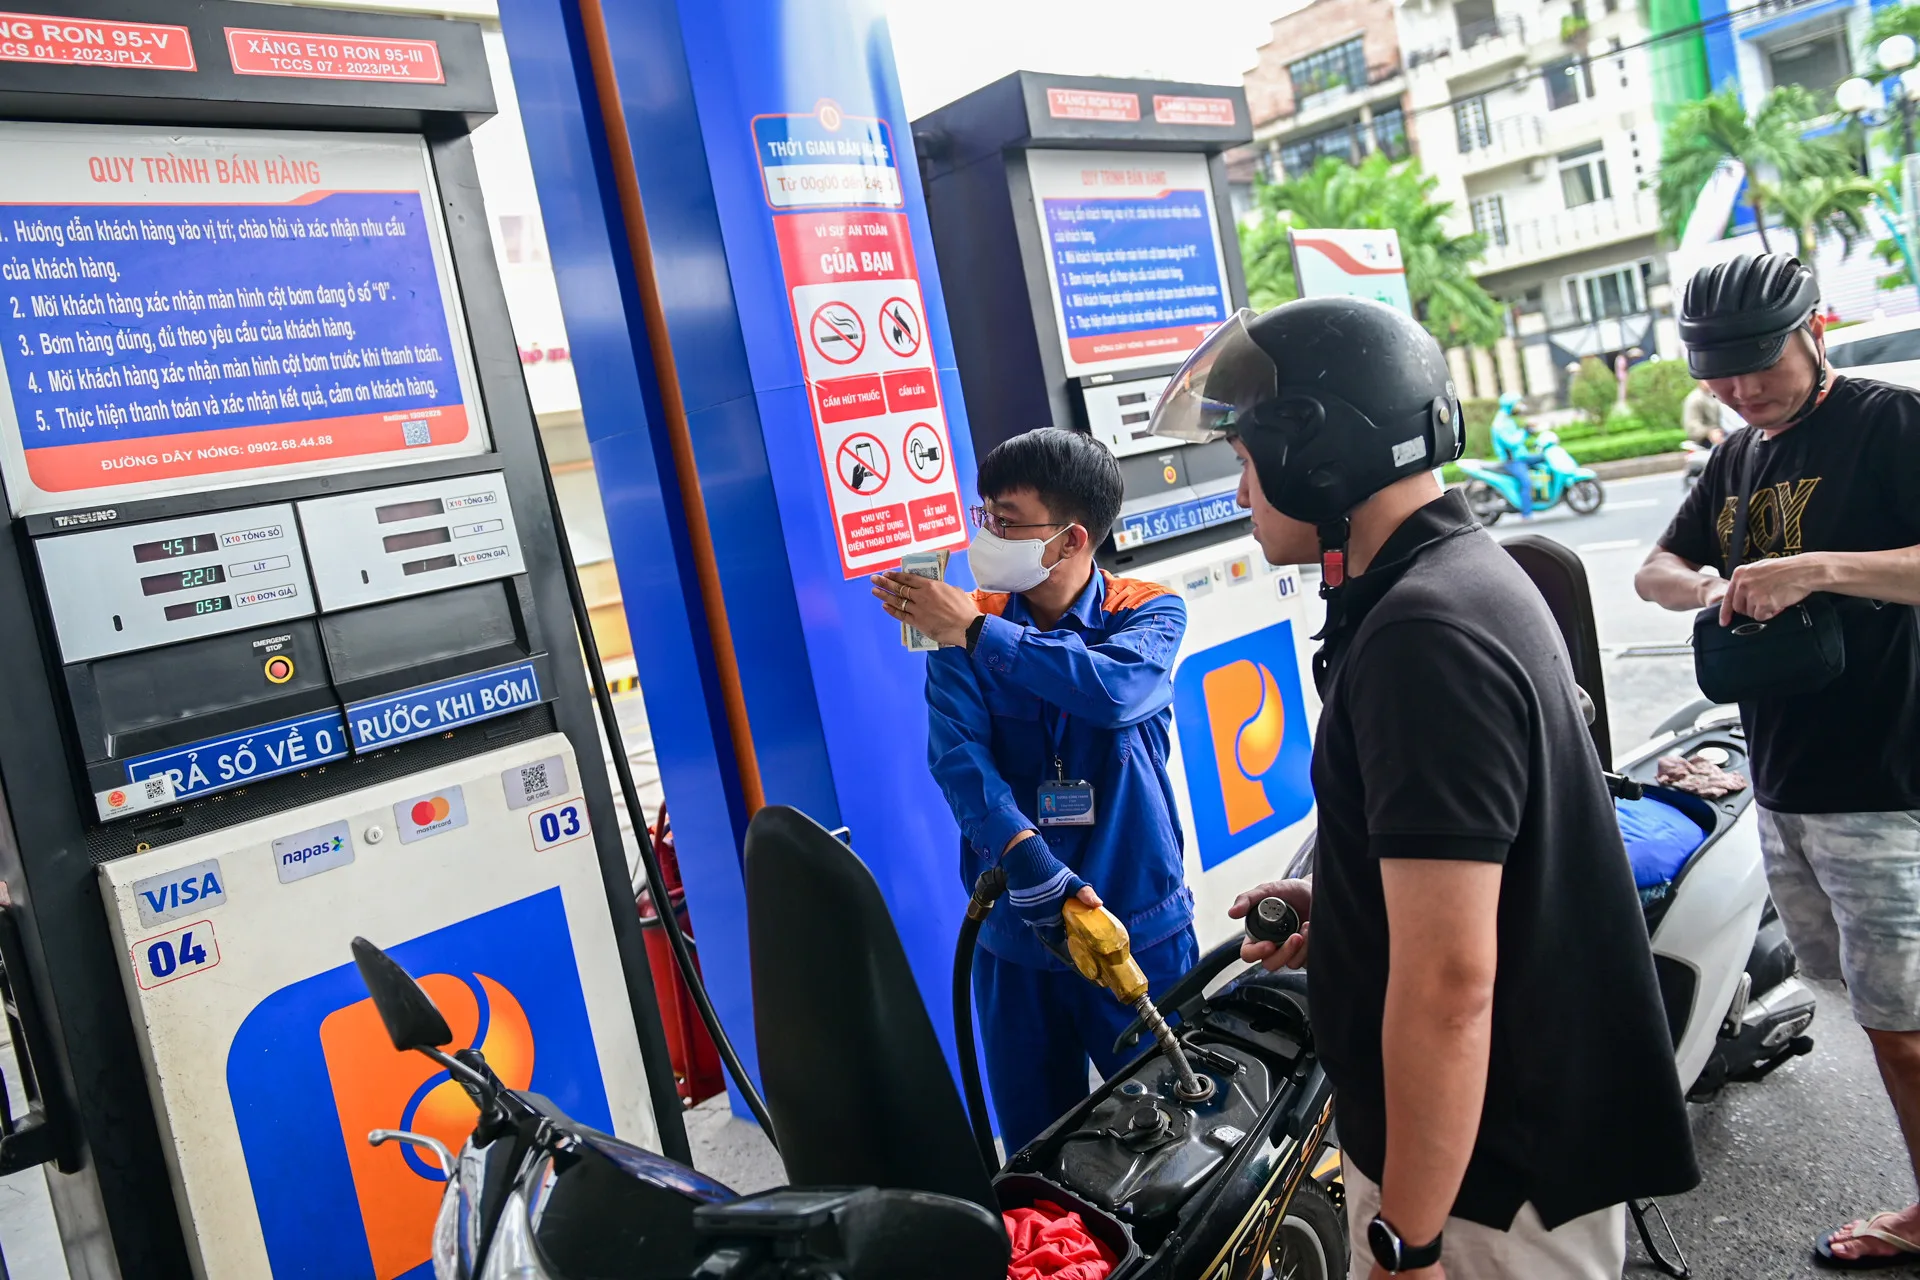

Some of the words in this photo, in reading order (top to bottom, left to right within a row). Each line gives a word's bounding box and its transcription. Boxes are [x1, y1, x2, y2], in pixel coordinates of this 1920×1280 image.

[42, 24, 104, 45] RON
[112, 31, 169, 49] 95-V
[34, 44, 54, 58] 01
[72, 47, 154, 64] 2023/PLX
[247, 37, 301, 56] XĂNG
[308, 44, 338, 58] E10
[343, 46, 380, 61] RON
[386, 48, 423, 63] 95-III
[271, 58, 313, 71] TCCS
[318, 60, 333, 72] 07
[347, 62, 410, 76] 2023/PLX
[768, 137, 804, 157] THỜI
[806, 141, 835, 156] GIAN
[88, 156, 134, 182] QUY
[141, 152, 210, 184] TRÌNH
[215, 154, 260, 184] BÁN
[264, 154, 321, 184] HÀNG
[777, 177, 797, 192] Từ
[13, 219, 65, 247] Hướng
[66, 215, 94, 242] dẫn
[95, 219, 139, 241] khách
[139, 219, 176, 246] hàng
[176, 219, 201, 240] vào
[202, 219, 217, 245] vị
[216, 218, 237, 243] trí;
[238, 218, 269, 239] chào
[268, 217, 289, 239] hỏi
[289, 217, 307, 238] và
[306, 217, 329, 238] xác
[329, 217, 361, 242] nhận
[360, 217, 385, 238] nhu
[384, 214, 407, 238] cầu
[848, 225, 862, 237] AN
[863, 222, 888, 237] TOÀN
[2, 256, 31, 281] của
[31, 257, 78, 279] khách
[79, 256, 121, 283] hàng.
[820, 246, 858, 275] CỦA
[861, 251, 895, 277] BẠN
[9, 296, 25, 319] 2.
[31, 295, 59, 317] Mời
[60, 293, 106, 316] khách
[106, 292, 144, 319] hàng
[144, 290, 170, 313] xác
[171, 289, 206, 315] nhận
[207, 288, 236, 309] màn
[235, 287, 266, 308] hình
[267, 285, 288, 311] cột
[287, 285, 315, 306] bơm
[316, 284, 347, 308] đang
[357, 280, 372, 303] số
[18, 334, 34, 357] 3.
[39, 333, 75, 355] Bơm
[75, 330, 115, 357] hàng
[115, 328, 157, 354] đúng,
[157, 324, 177, 348] đủ
[177, 325, 207, 347] theo
[208, 323, 234, 350] yêu
[235, 319, 259, 343] cầu
[260, 319, 284, 341] của
[283, 318, 322, 340] khách
[321, 317, 356, 341] hàng.
[35, 409, 51, 431] 5.
[55, 407, 95, 433] Thực
[95, 403, 128, 429] hiện
[129, 399, 170, 423] thanh
[170, 396, 202, 419] toán
[202, 394, 220, 415] và
[221, 392, 245, 414] xác
[246, 389, 279, 415] nhận
[278, 385, 300, 409] kết
[301, 383, 328, 411] quả,
[328, 382, 354, 404] cảm
[370, 378, 406, 399] khách
[405, 376, 439, 399] hàng.
[842, 392, 857, 405] HÚT
[101, 454, 159, 471] ĐƯỜNG
[161, 449, 193, 463] DÂY
[197, 445, 244, 459] NÓNG:
[247, 435, 333, 454] 0902.68.44.88
[55, 510, 118, 526] TATSUNO
[861, 514, 875, 523] KHU
[1154, 511, 1169, 534] SỐ
[225, 534, 241, 545] X10
[267, 527, 280, 538] SỐ
[254, 561, 266, 571] LÍT
[240, 594, 256, 605] X10
[257, 590, 277, 601] ĐƠN
[277, 587, 293, 598] GIÁ
[1278, 576, 1295, 596] 01
[196, 598, 222, 614] 053
[253, 635, 292, 648] EMERGENCY
[265, 644, 283, 653] STOP
[218, 738, 257, 780] SỐ
[265, 727, 308, 766] VỀ
[315, 730, 333, 755] 0
[436, 691, 475, 723] KHI
[480, 678, 533, 711] BƠM
[536, 790, 551, 799] CODE
[416, 819, 452, 835] mastercard
[539, 806, 581, 843] 03
[283, 841, 330, 865] napas
[138, 872, 222, 914] VISA
[147, 932, 207, 978] 04
